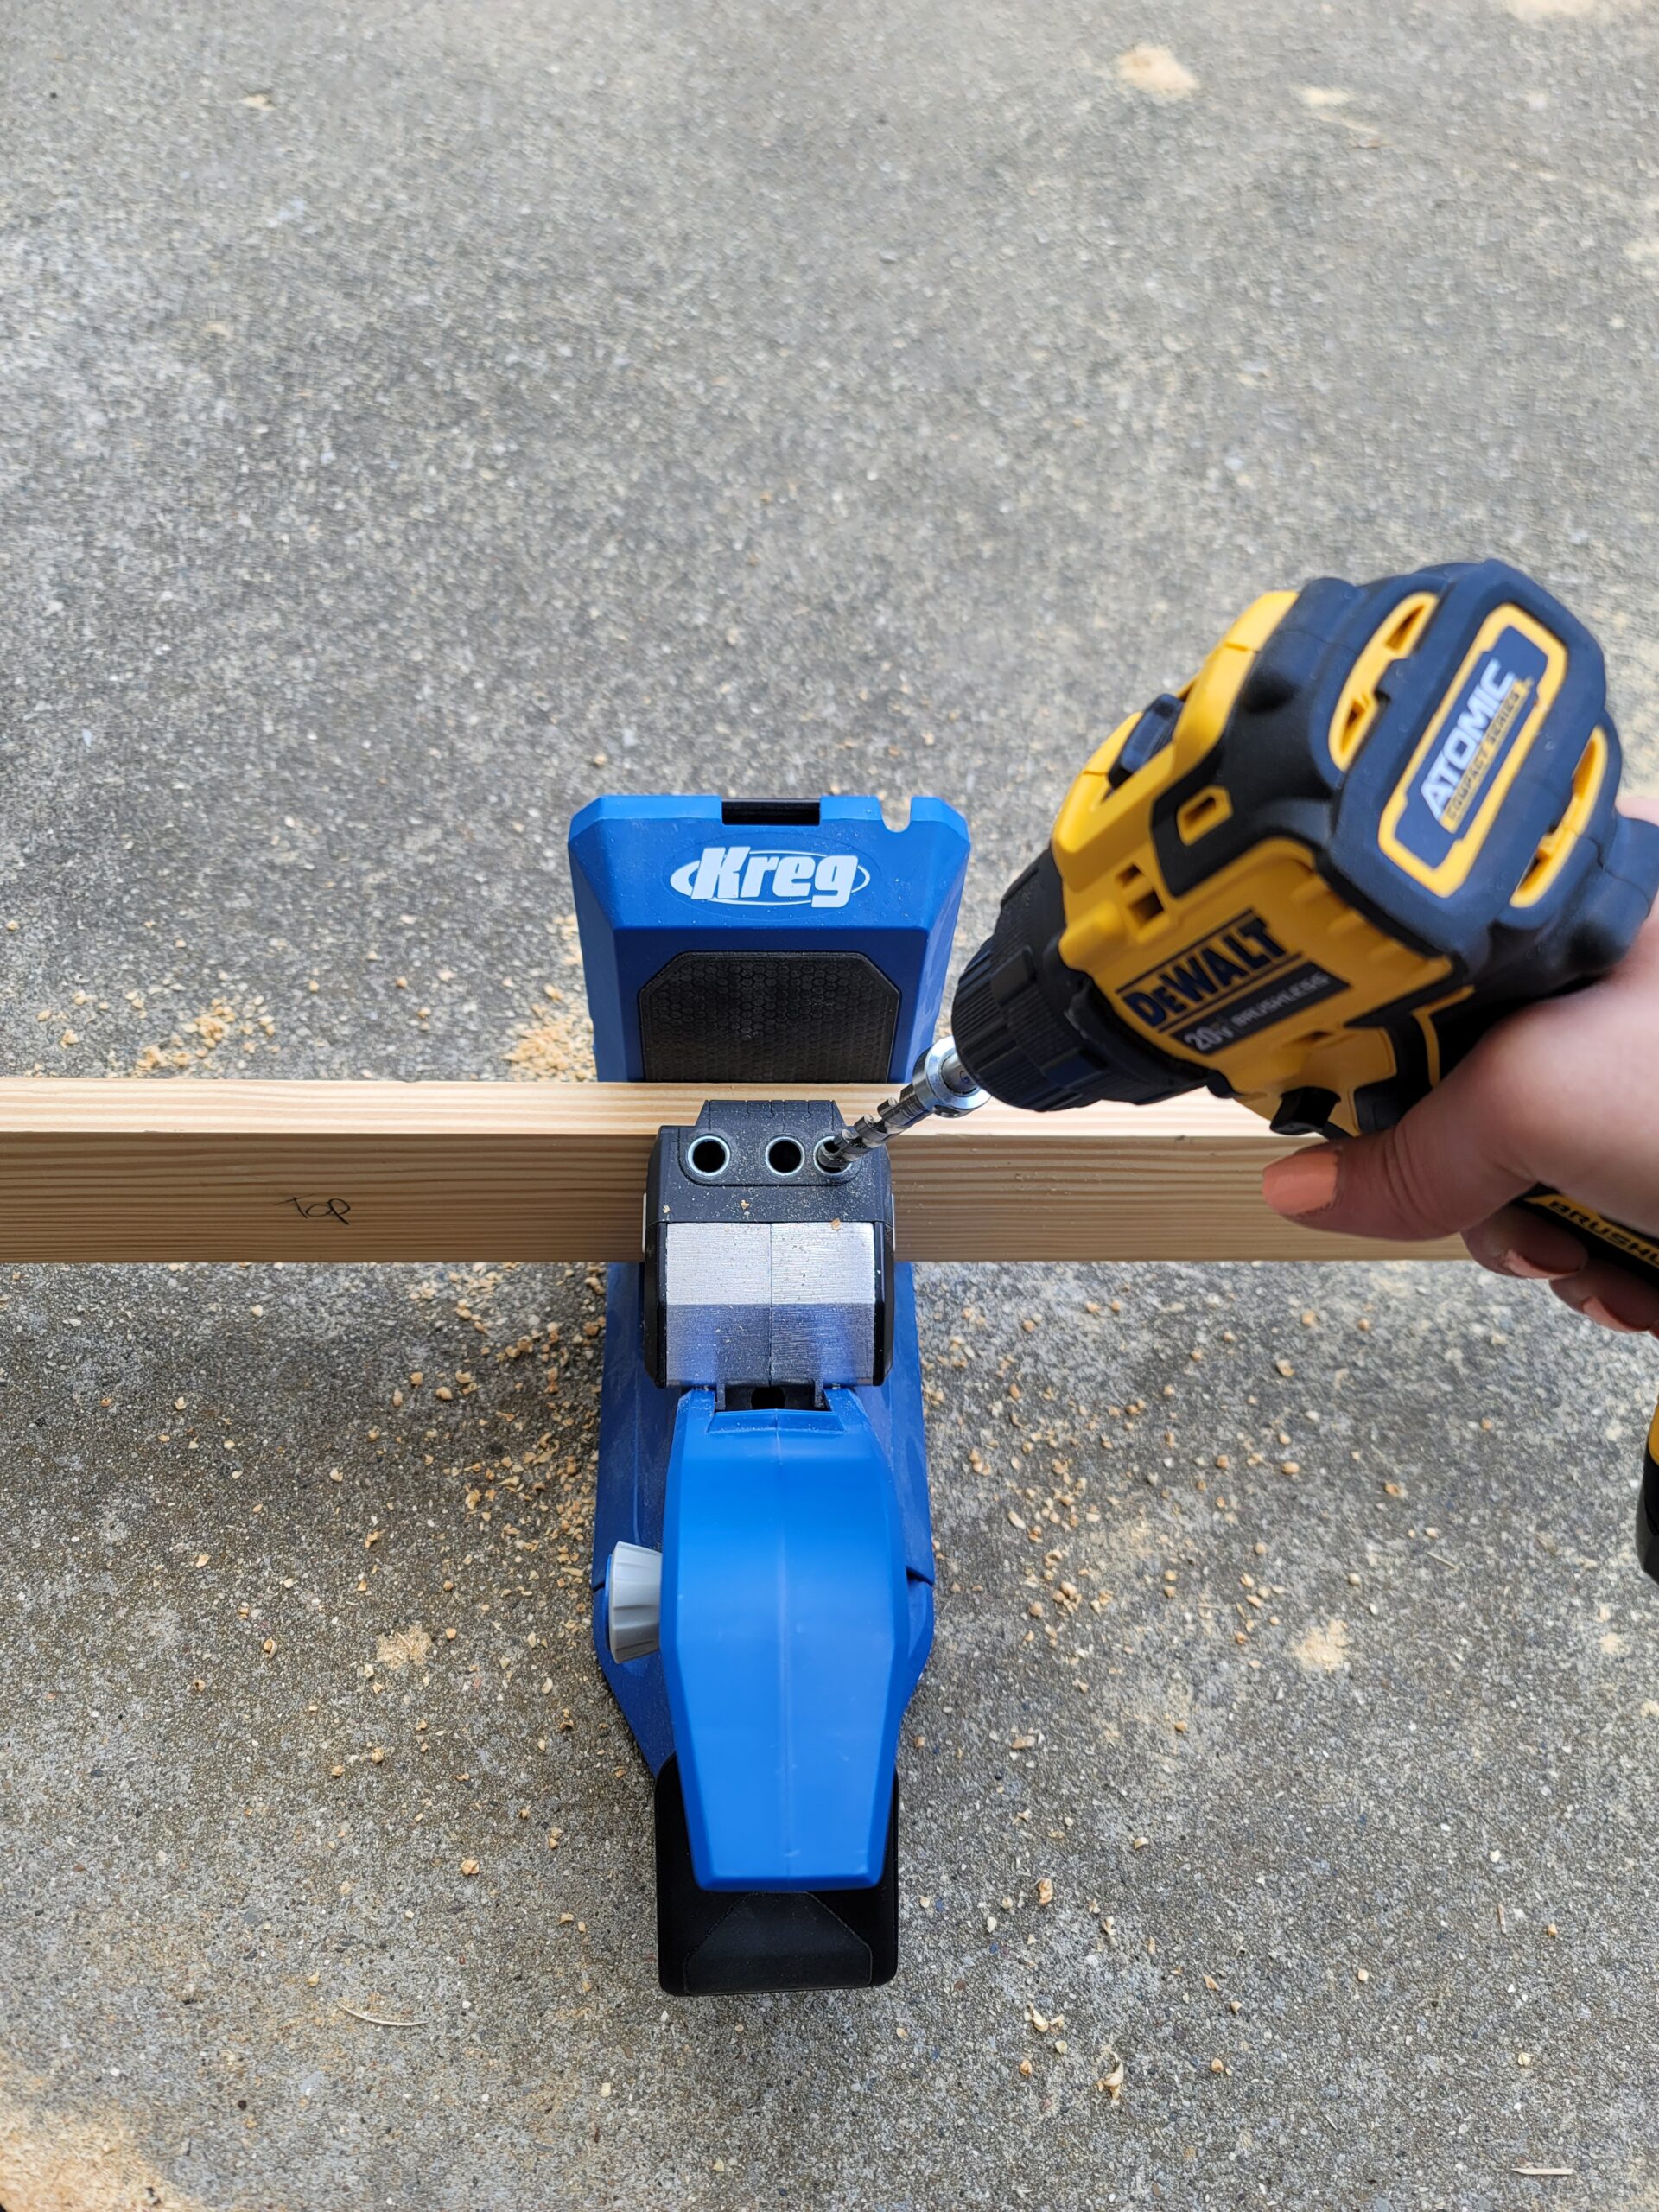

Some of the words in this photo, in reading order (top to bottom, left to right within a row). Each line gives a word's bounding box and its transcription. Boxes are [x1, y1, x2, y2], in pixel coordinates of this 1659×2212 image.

[1421, 658, 1516, 821] ATOMIC
[1446, 745, 1489, 821] COMPACT
[1485, 690, 1521, 745] SERIES
[691, 846, 859, 907] Kreg
[1230, 971, 1331, 1027] BRUSHLESS
